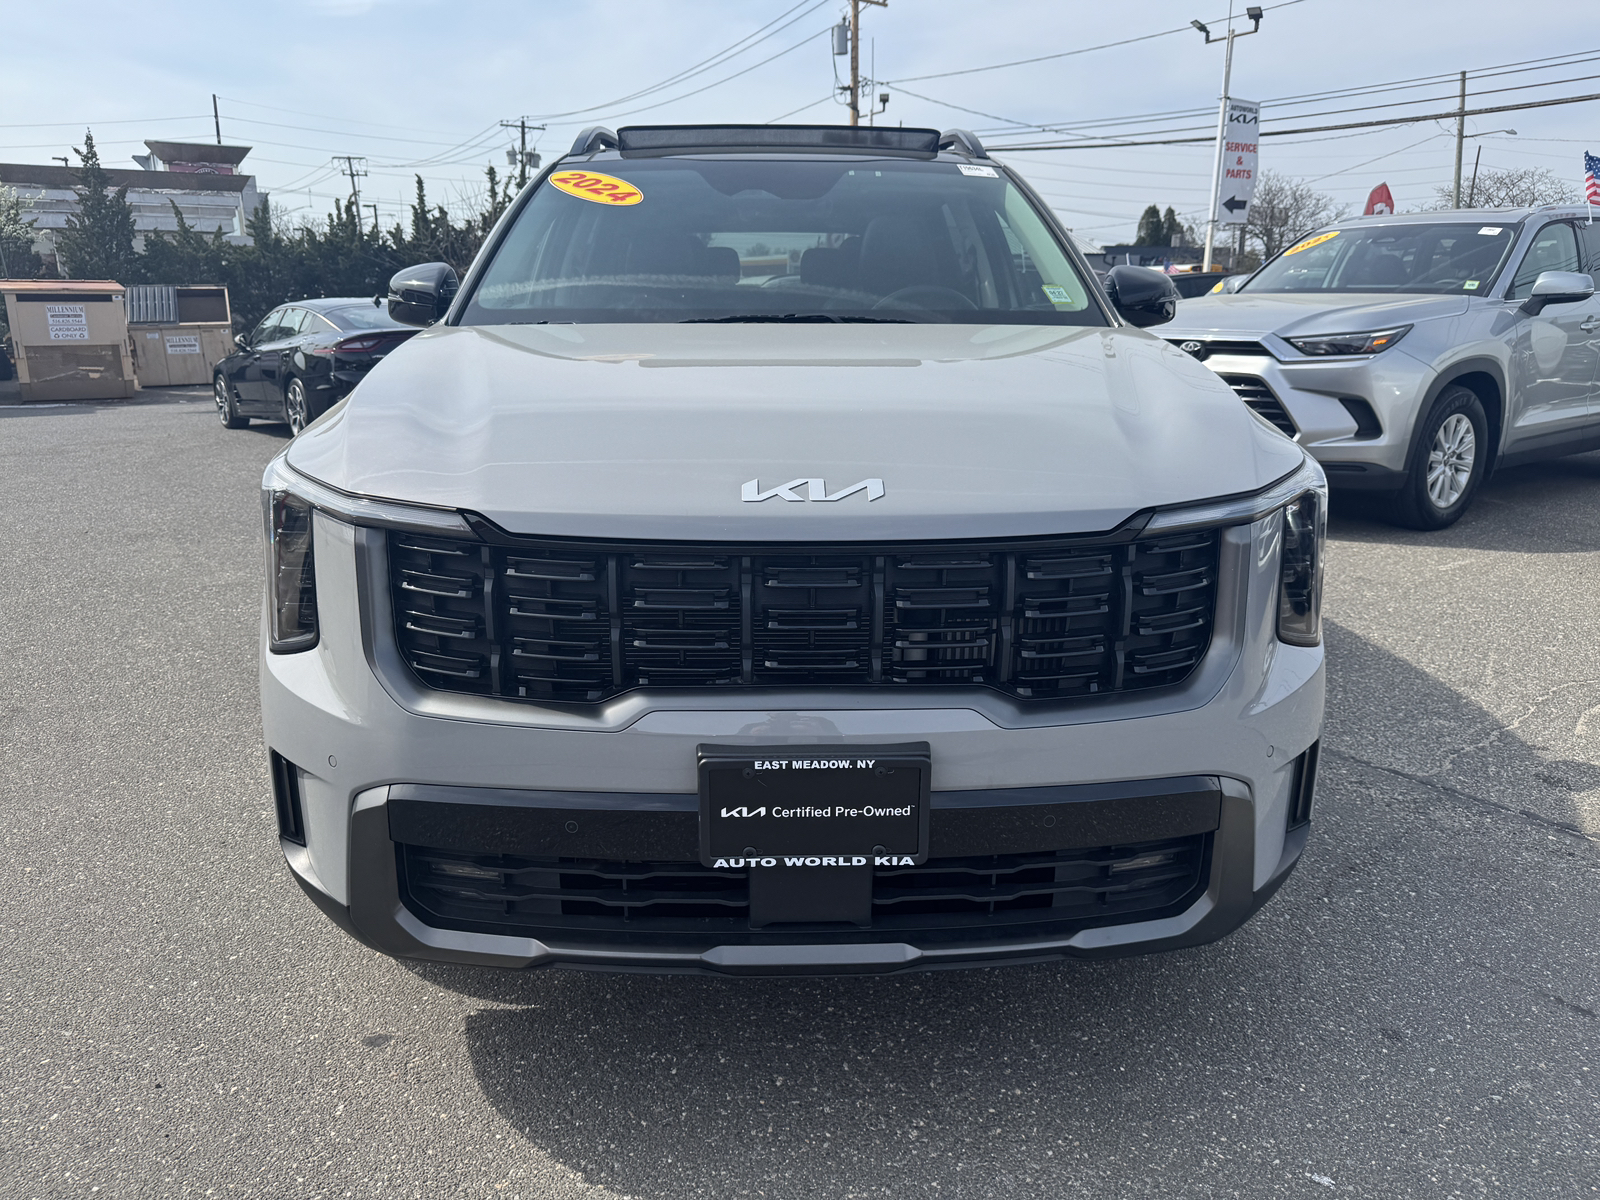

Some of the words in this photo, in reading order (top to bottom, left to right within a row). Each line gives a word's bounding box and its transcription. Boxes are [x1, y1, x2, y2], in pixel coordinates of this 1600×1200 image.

[1230, 104, 1258, 114] AUTOWORLD
[1229, 113, 1258, 125] KIA
[1225, 142, 1257, 154] SERVICE
[1236, 156, 1243, 166] &
[1225, 168, 1252, 179] PARTS
[553, 173, 638, 202] 2024
[741, 478, 885, 502] KIA
[754, 760, 789, 770] EAST
[857, 760, 875, 769] NY
[720, 806, 766, 818] KIA
[772, 806, 831, 818] Certified
[713, 857, 777, 868] AUTO
[784, 856, 866, 867] WORLD
[874, 856, 915, 866] KIA
